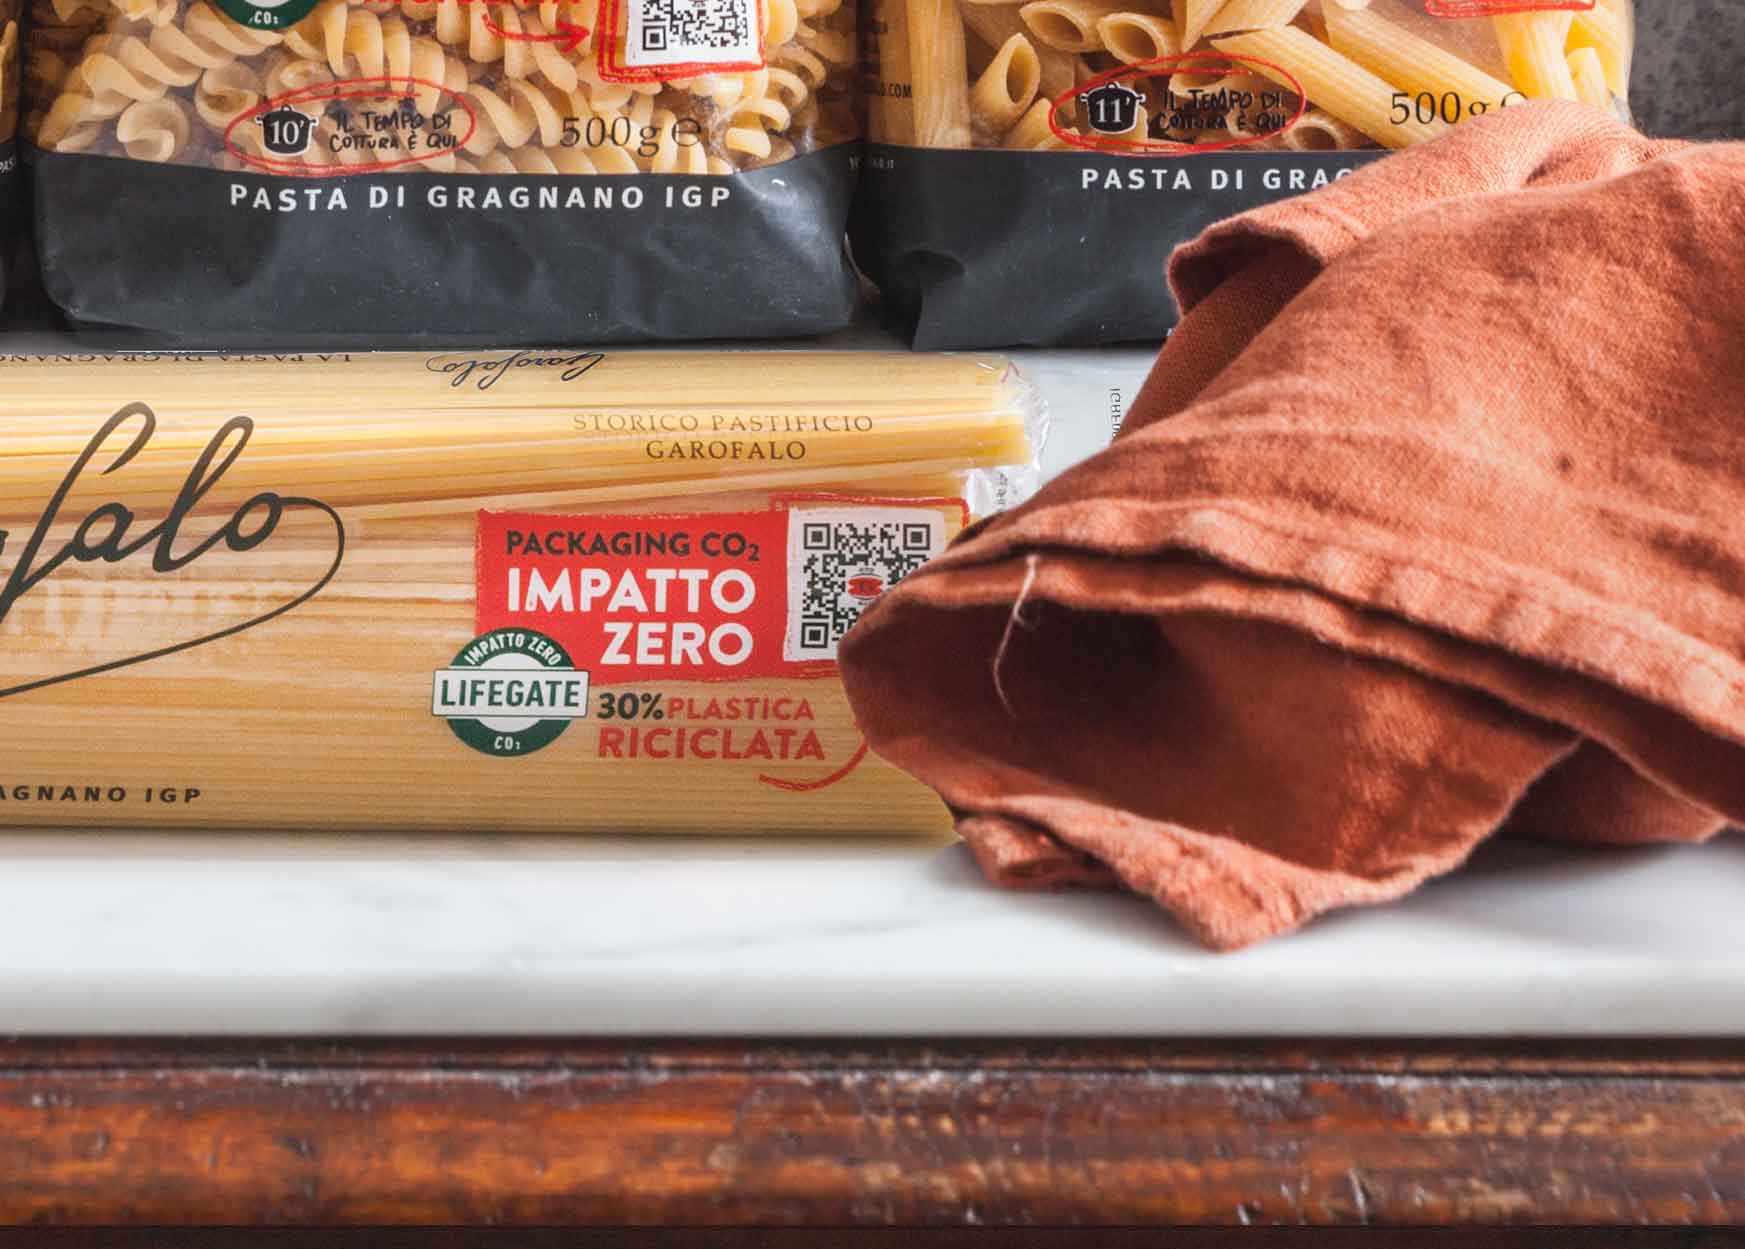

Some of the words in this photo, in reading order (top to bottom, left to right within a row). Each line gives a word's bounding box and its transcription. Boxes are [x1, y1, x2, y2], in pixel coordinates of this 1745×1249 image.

[1163, 93, 1181, 112] IL
[1190, 90, 1252, 112] TEMPO
[1260, 91, 1283, 109] DI
[336, 114, 354, 133] IL
[361, 111, 423, 132] TEMPO
[432, 112, 451, 131] DI
[329, 131, 399, 151] COTTURA
[426, 133, 461, 151] QUI
[559, 116, 660, 157] 500g
[1081, 168, 1193, 190] PASTA
[1211, 168, 1244, 190] DI
[230, 182, 348, 212] PASTA
[369, 184, 405, 210] DI
[427, 186, 644, 211] GRAGNANO
[665, 186, 731, 209] IGP
[573, 414, 699, 432] STORICO
[712, 415, 874, 433] PASTIFICIO
[645, 440, 807, 461] GAROFALO
[505, 530, 691, 558] PACKAGING
[507, 567, 756, 613] IMPATTO
[463, 633, 525, 666] IMPATTO
[527, 636, 562, 666] ZERO
[599, 622, 754, 666] ZERO
[440, 679, 581, 708] LIFEGATE
[596, 692, 665, 720] 30%
[667, 697, 816, 721] PLASTICA
[598, 727, 826, 761] RICICLATA
[144, 787, 202, 803] IGP
